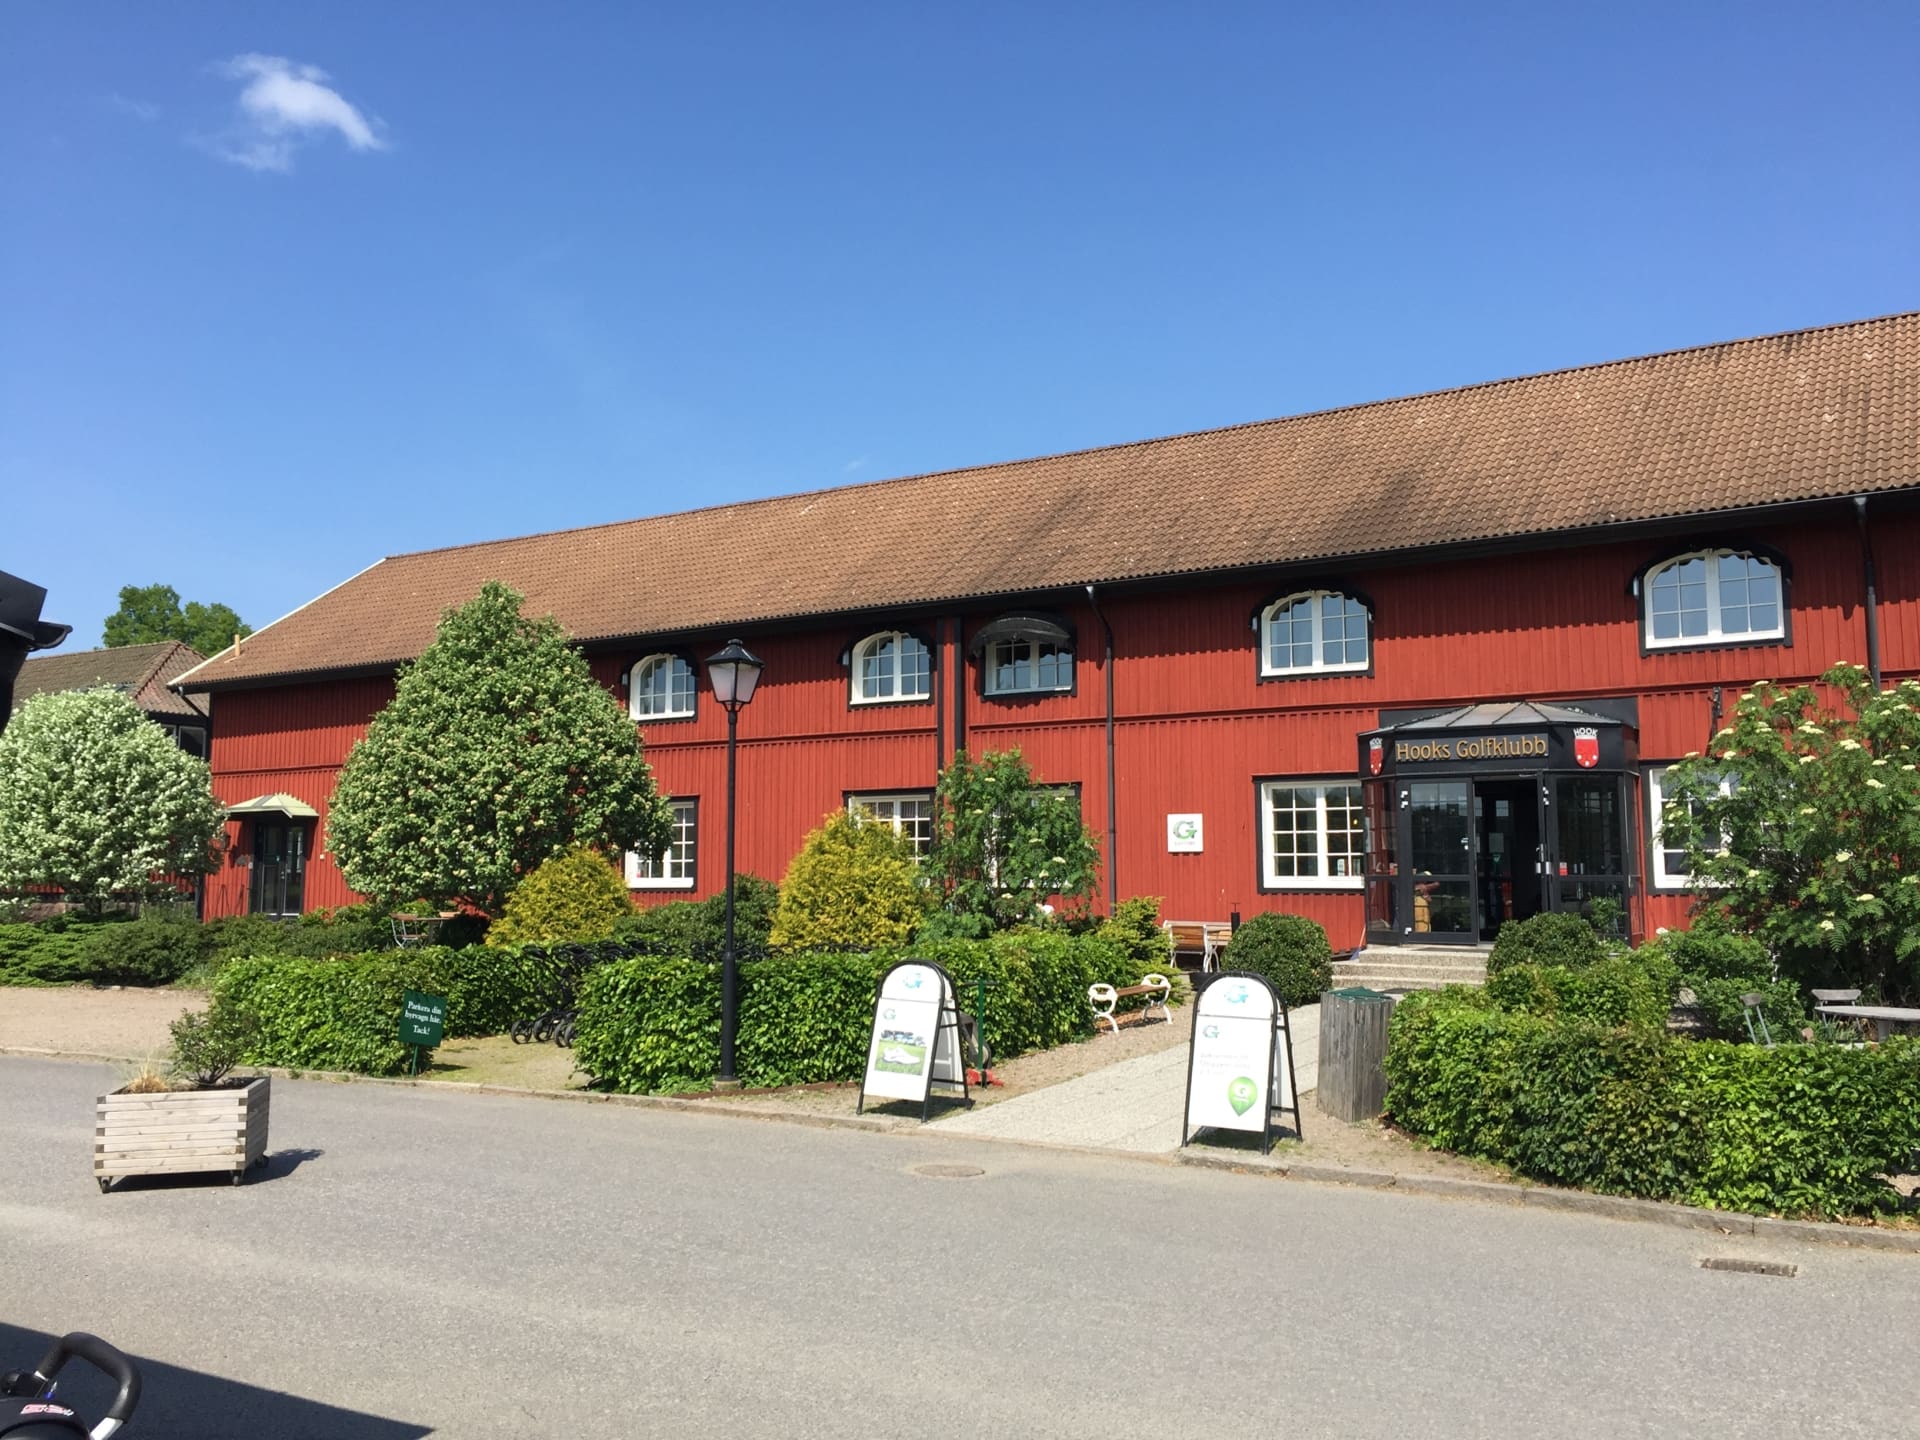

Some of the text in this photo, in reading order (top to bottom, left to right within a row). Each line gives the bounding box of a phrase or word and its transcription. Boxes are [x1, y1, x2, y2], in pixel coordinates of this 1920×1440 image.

[1573, 727, 1598, 737] HOOK
[1396, 735, 1547, 760] Hooks Golfklubb
[408, 1001, 441, 1014] Parkera din
[413, 1024, 431, 1035] Tack!
